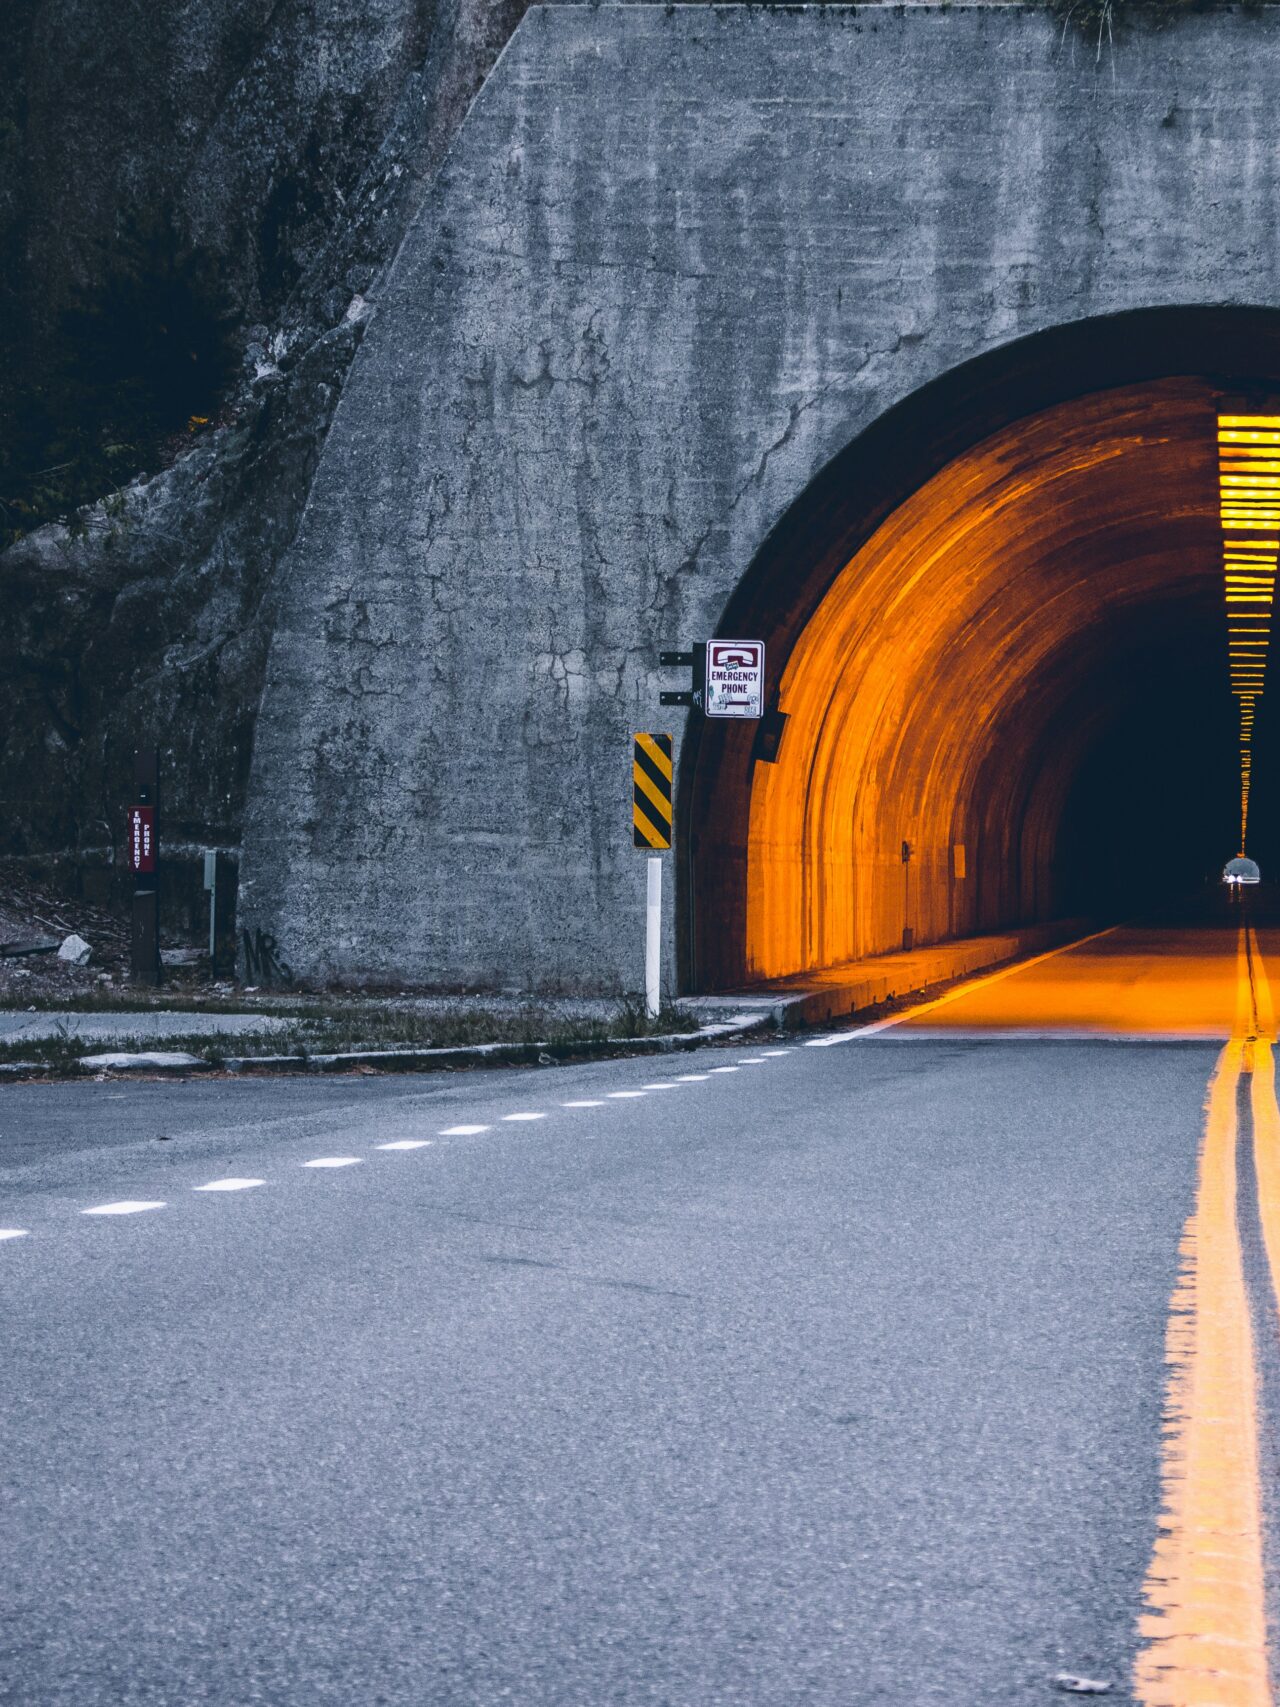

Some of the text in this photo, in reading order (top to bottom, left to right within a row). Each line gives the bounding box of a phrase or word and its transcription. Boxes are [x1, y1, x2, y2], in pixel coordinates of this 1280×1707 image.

[711, 671, 758, 681] EMERGENCY
[721, 684, 748, 693] PHONE
[133, 811, 141, 868] EMERGENCY
